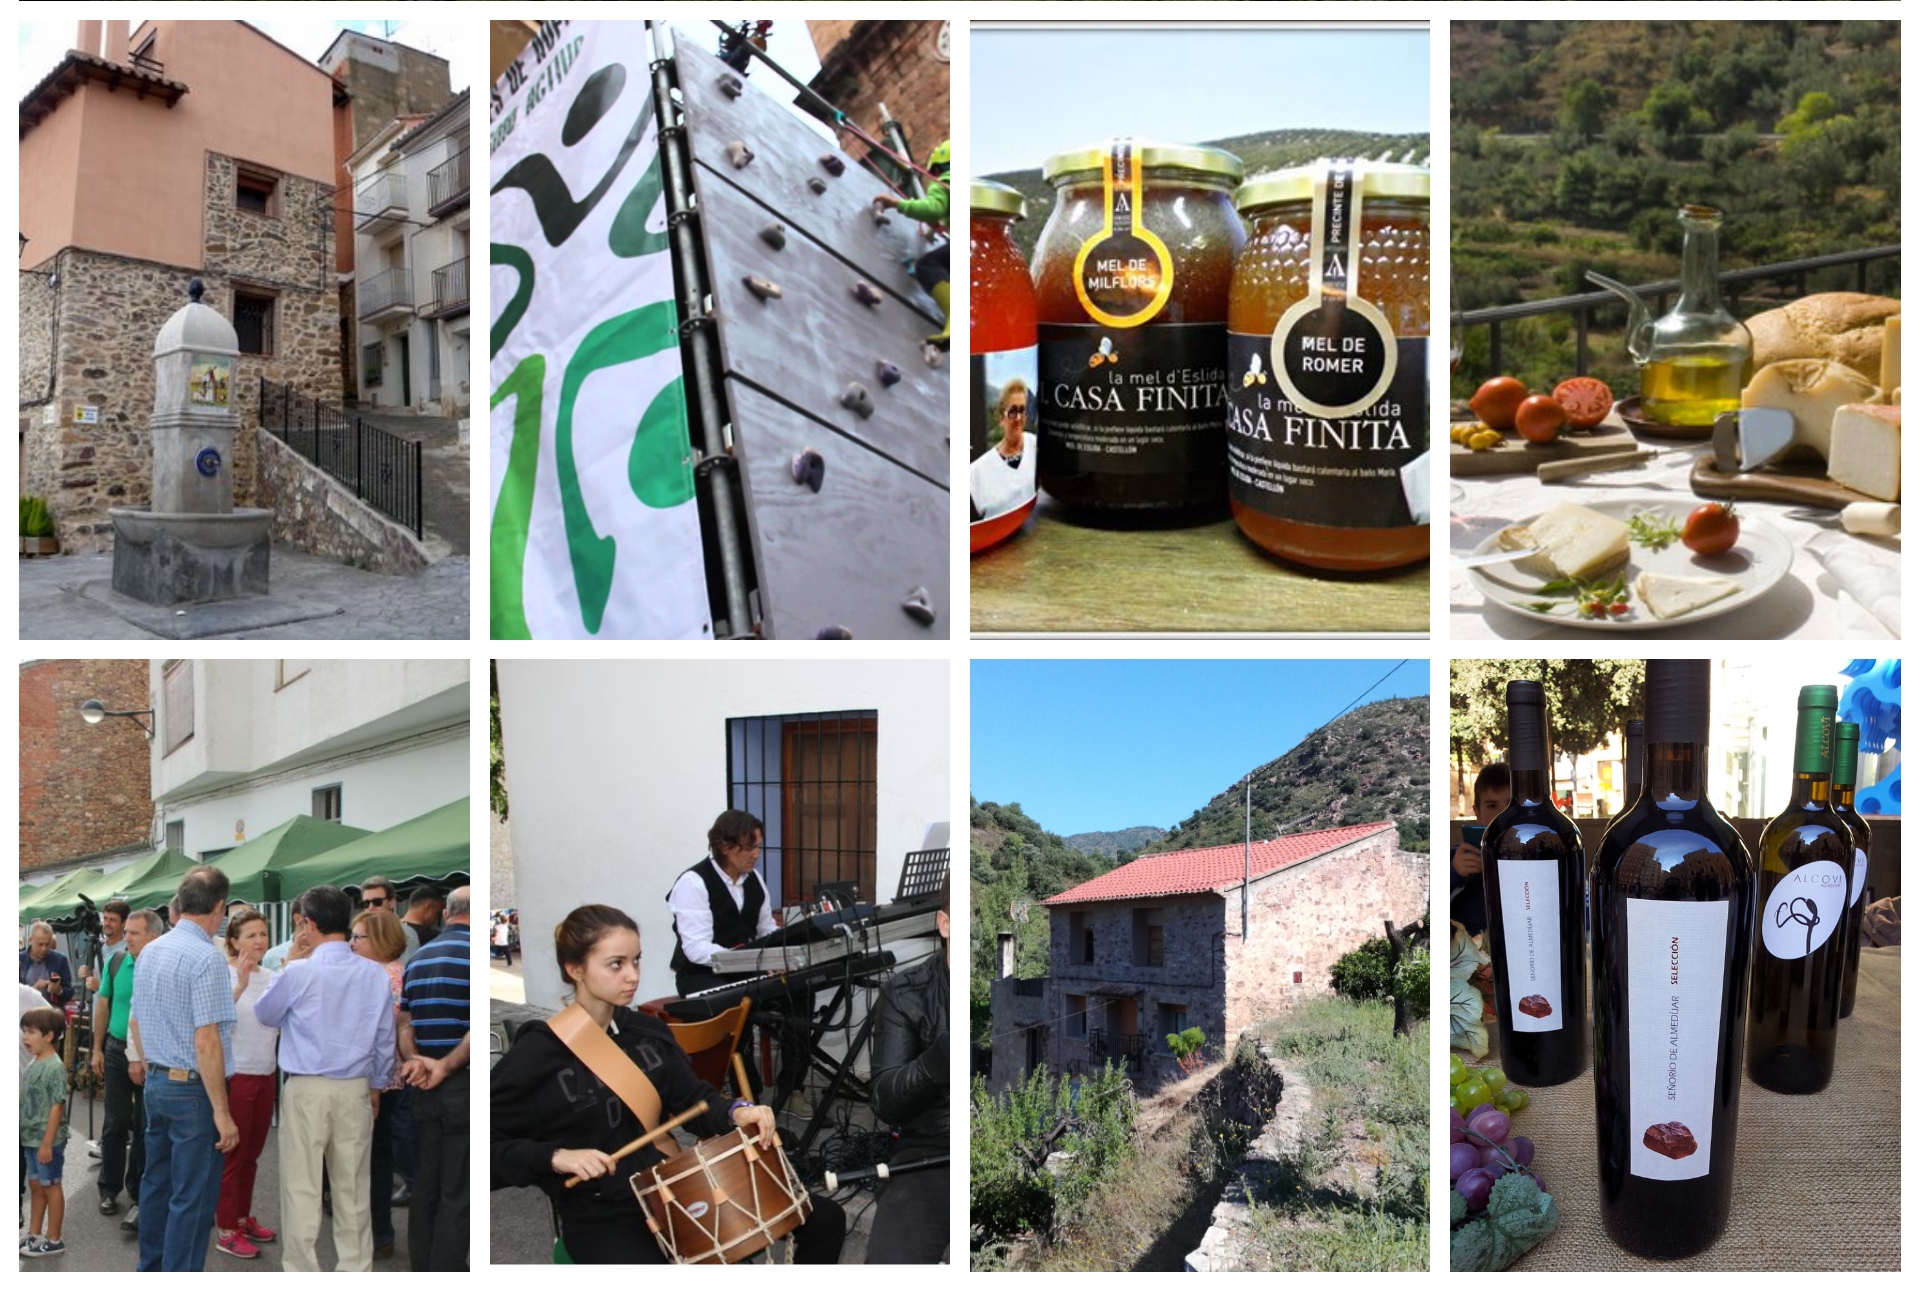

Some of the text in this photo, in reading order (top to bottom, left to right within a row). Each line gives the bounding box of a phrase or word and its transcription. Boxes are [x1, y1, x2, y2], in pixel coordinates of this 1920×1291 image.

[1331, 192, 1345, 243] PRECINTE
[1096, 259, 1147, 272] MEL DE
[1088, 275, 1155, 289] MILFLORS
[1302, 336, 1366, 352] MEL DE
[1302, 357, 1364, 374] ROMER
[1108, 371, 1123, 385] la
[1129, 370, 1161, 385] mel
[1054, 383, 1126, 411] CASA
[1136, 382, 1230, 411] FINITA
[1257, 393, 1271, 410] la
[1227, 402, 1412, 450] CASA FINITA
[1793, 874, 1842, 884] ALCOVI
[1670, 936, 1679, 985] SELECCIÓN
[1669, 1047, 1678, 1061] DE
